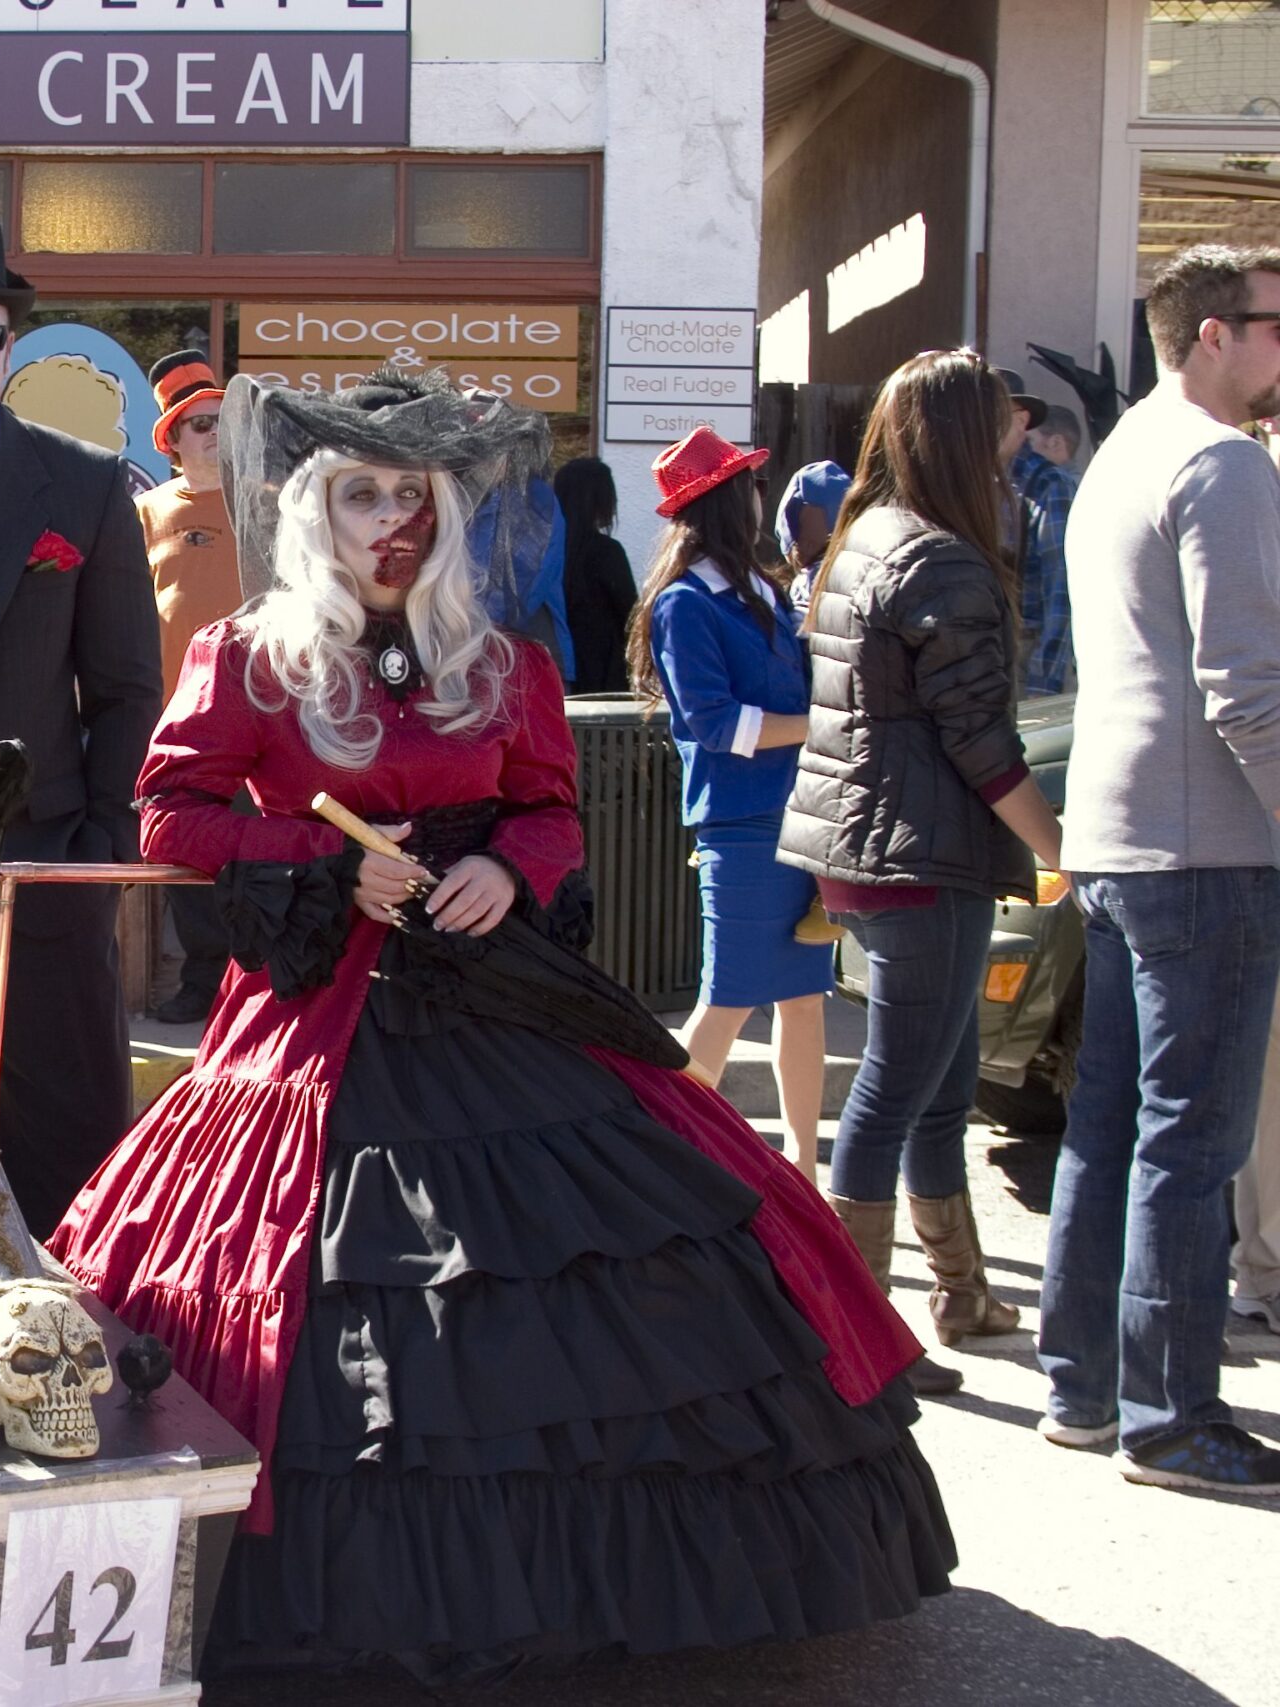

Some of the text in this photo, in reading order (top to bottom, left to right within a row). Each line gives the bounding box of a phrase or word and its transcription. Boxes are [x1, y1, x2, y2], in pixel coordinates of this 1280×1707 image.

[37, 50, 365, 126] CREAM
[255, 312, 561, 345] chocolate
[620, 320, 742, 338] Hand-Made
[627, 336, 735, 354] Chocolate
[389, 346, 426, 368] &
[623, 375, 737, 397] Real Fudge
[24, 1566, 137, 1667] 42
